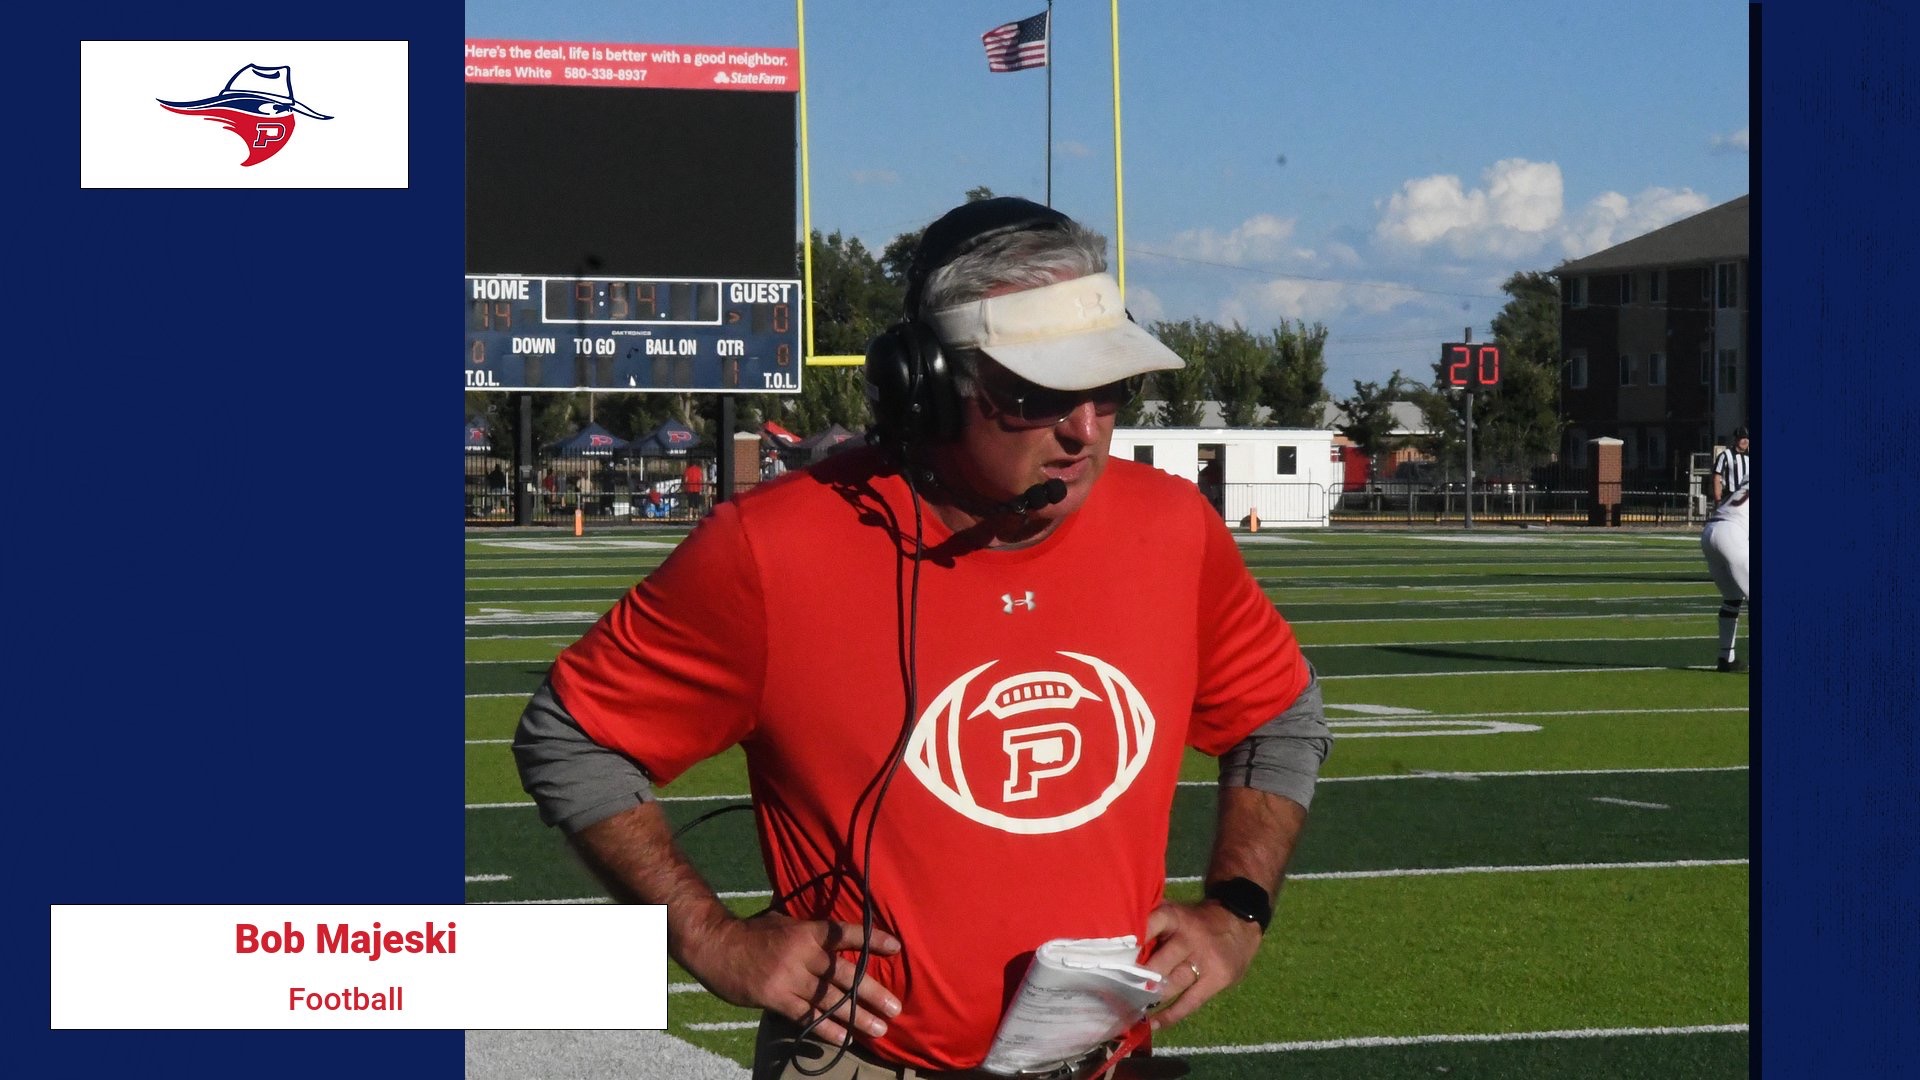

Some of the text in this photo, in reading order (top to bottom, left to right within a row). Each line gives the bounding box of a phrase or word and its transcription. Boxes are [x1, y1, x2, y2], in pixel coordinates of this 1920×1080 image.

[465, 45, 788, 68] Here's the deal, life is better with a good neighbor.
[465, 65, 647, 81] Charles White 580-338-8937
[473, 279, 529, 300] HOME
[730, 283, 791, 304] GUEST
[482, 302, 512, 328] 14
[512, 337, 556, 354] DOWN
[573, 338, 616, 355] TO GO
[646, 338, 697, 356] BALL ON
[717, 339, 744, 356] QTR
[1449, 346, 1500, 386] 20
[465, 370, 500, 387] T.O.L.
[763, 372, 797, 389] T.O.L.
[1002, 721, 1082, 803] P
